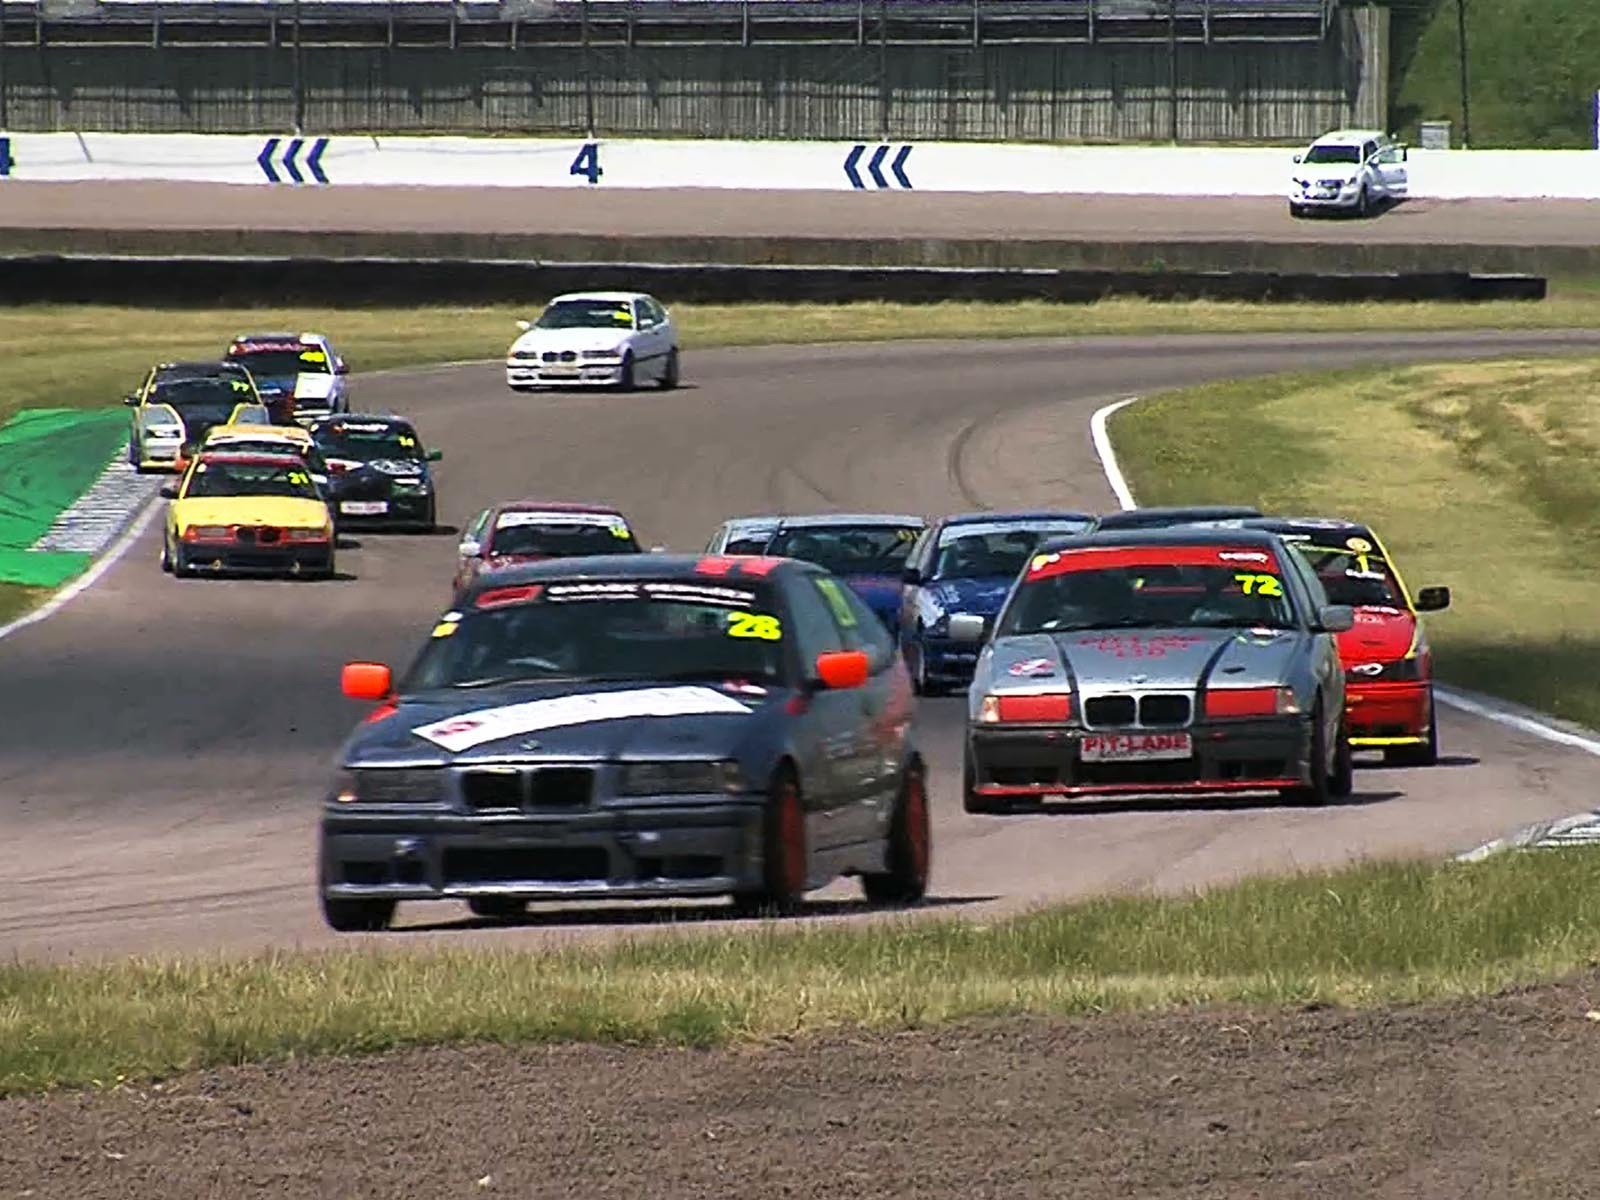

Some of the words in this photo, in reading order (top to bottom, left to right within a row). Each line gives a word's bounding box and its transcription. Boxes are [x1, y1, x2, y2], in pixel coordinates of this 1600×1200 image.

[570, 143, 603, 184] 4
[1234, 574, 1283, 597] 72
[727, 611, 782, 640] 28
